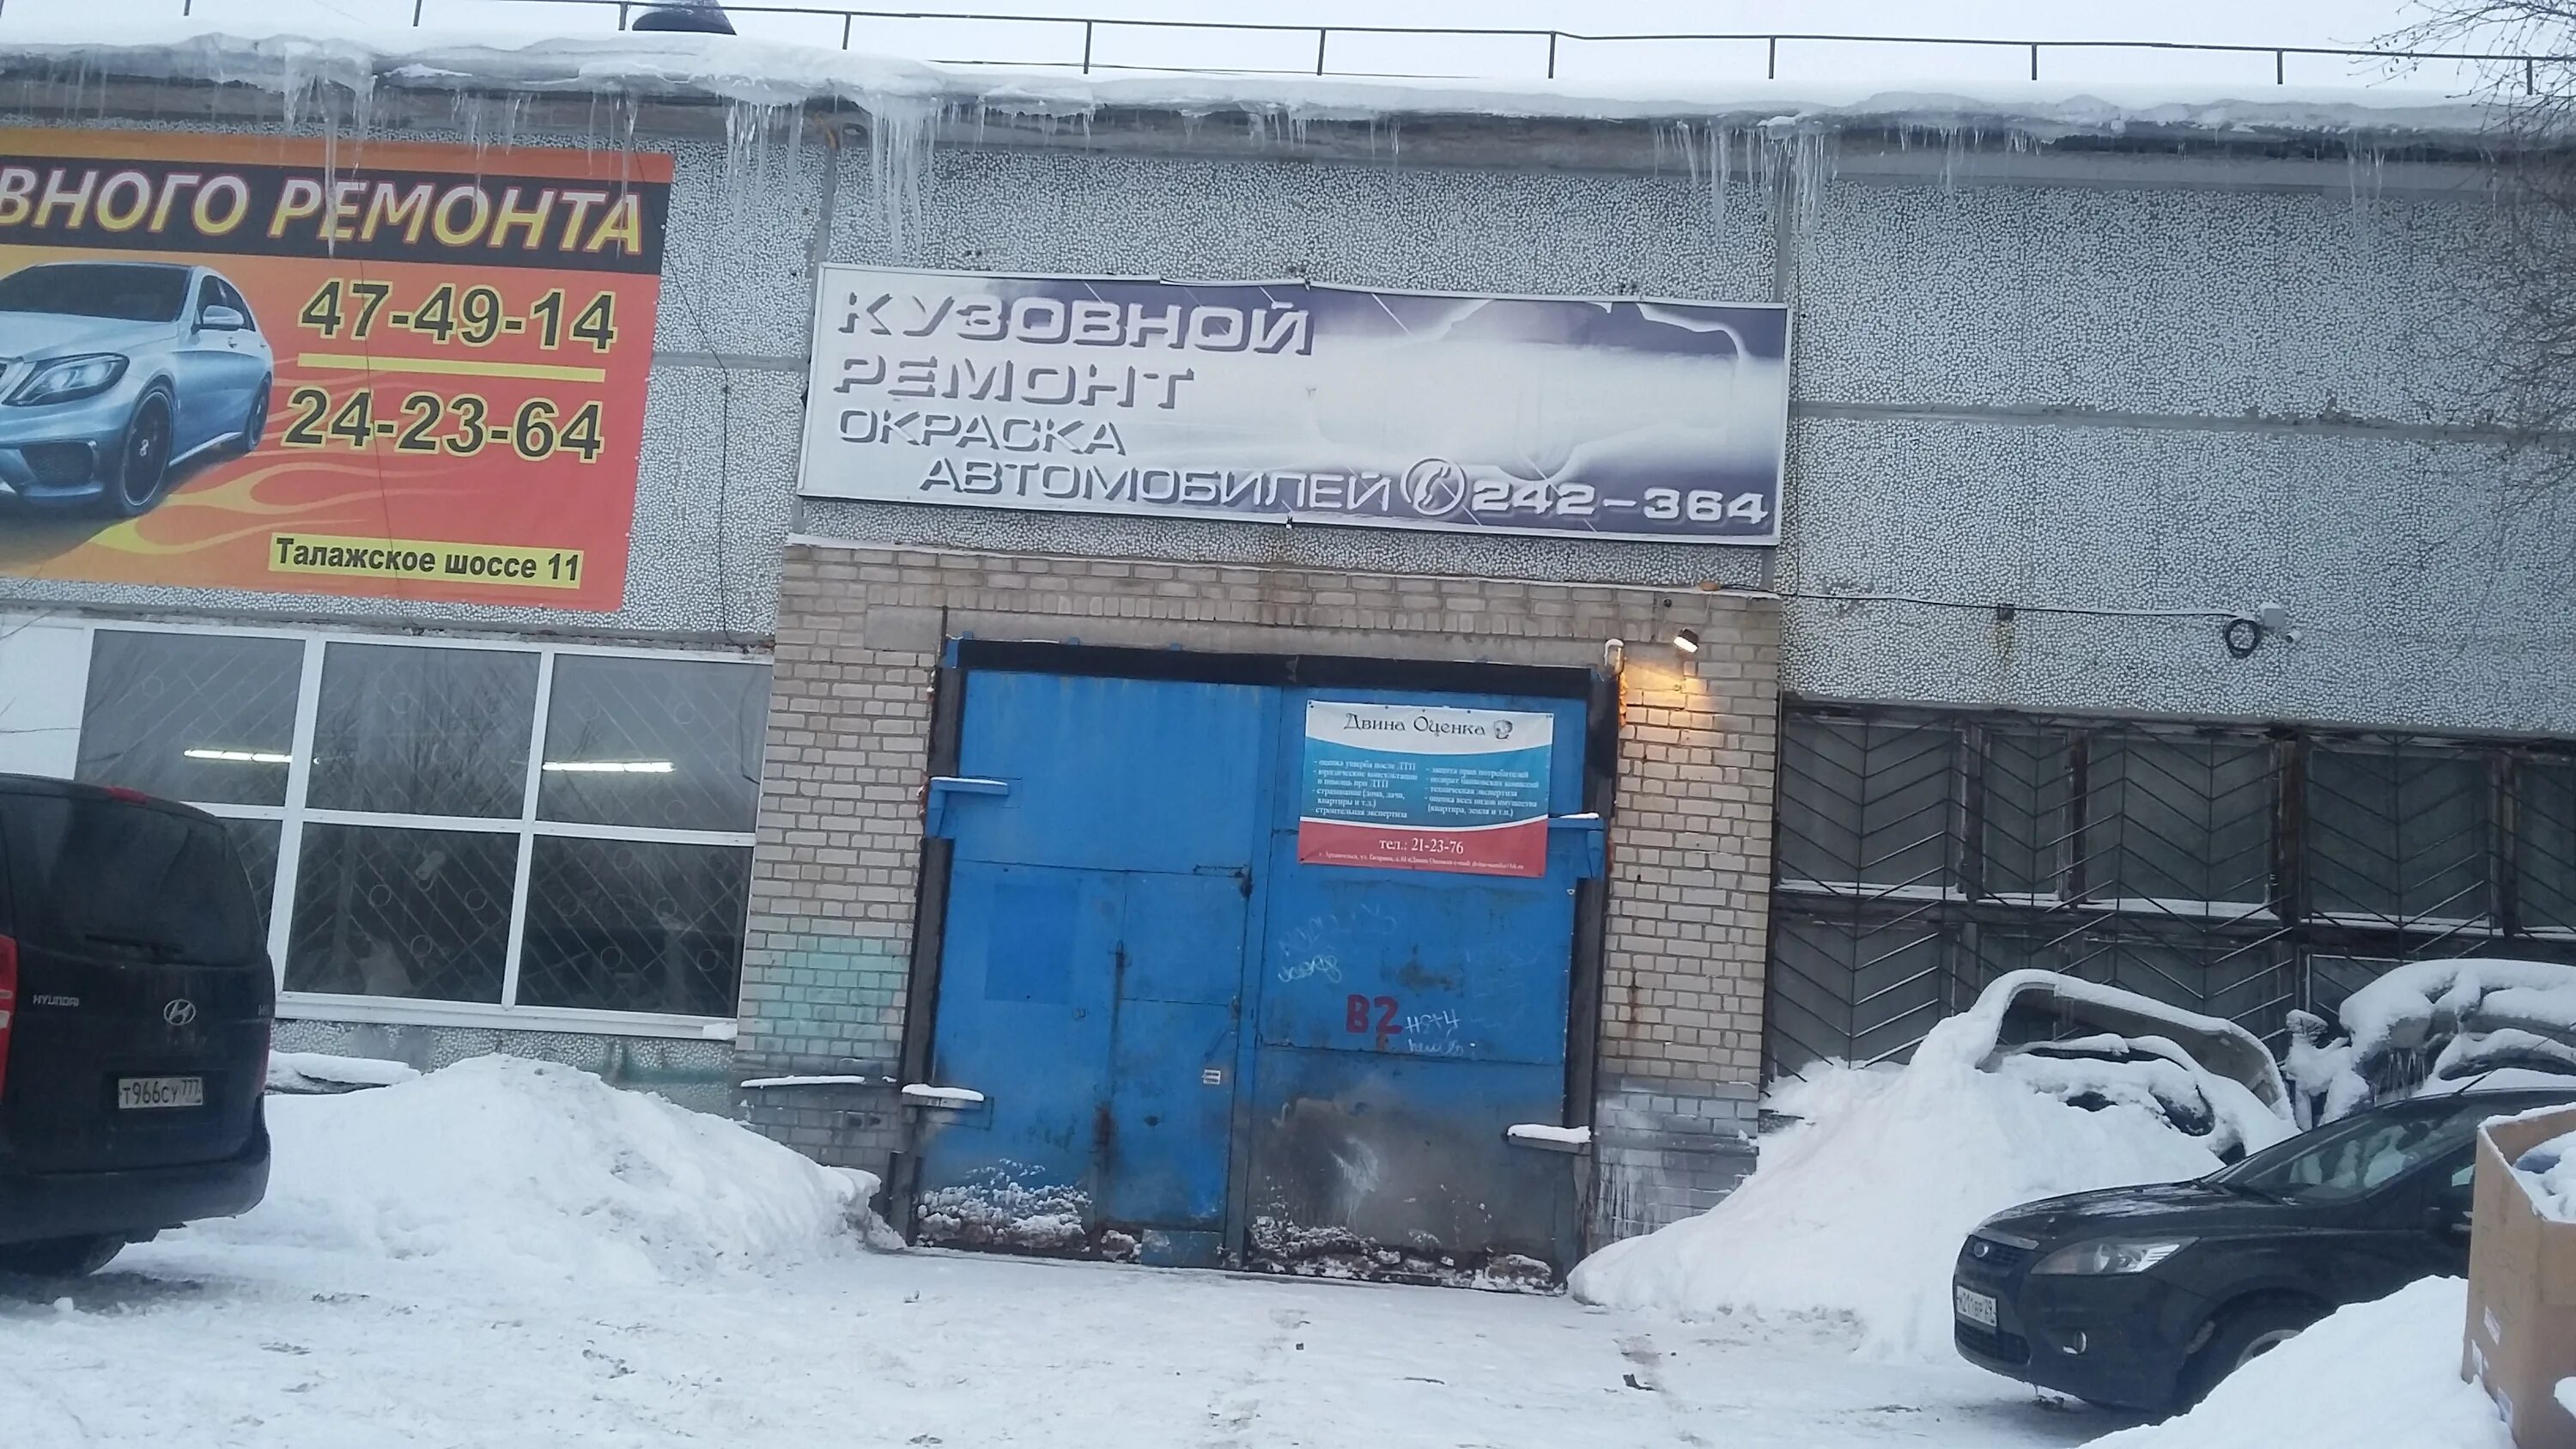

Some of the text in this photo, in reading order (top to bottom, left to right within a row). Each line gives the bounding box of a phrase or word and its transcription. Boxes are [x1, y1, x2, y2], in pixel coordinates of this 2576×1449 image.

[0, 167, 643, 256] ВНОГО РЕМОНТА
[297, 277, 618, 354] 47-49-14
[837, 290, 1313, 356] КУЗОВНОЙ
[833, 355, 1195, 410] РЕМОНТ
[283, 387, 605, 464] 24-23-64
[839, 408, 1127, 456] ОКРАСКА
[920, 456, 1770, 526] АВТОМОБИЛЕЙ 242-364
[276, 537, 580, 582] Талажское шоссе 11
[1343, 712, 1486, 737] Двина Оценка
[1411, 837, 1464, 855] 21-23-76
[33, 994, 79, 1008] HYUNDAI
[181, 1079, 200, 1096] 777
